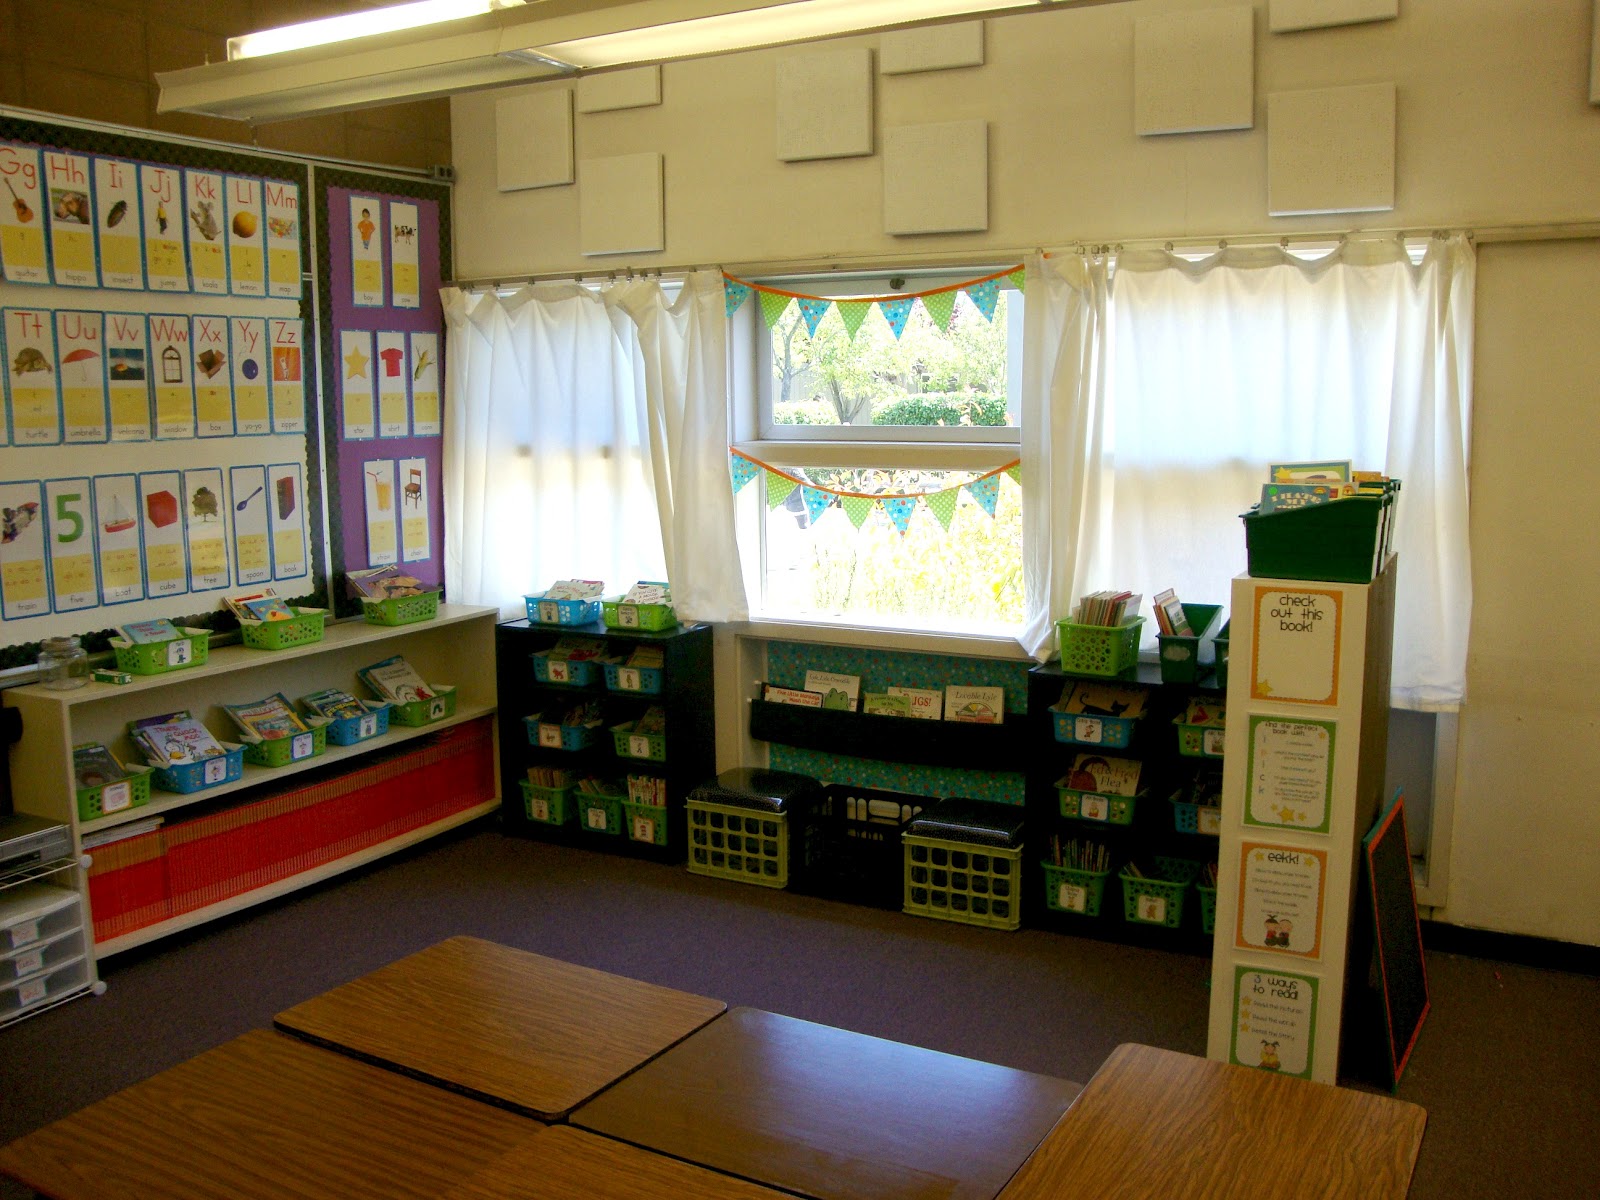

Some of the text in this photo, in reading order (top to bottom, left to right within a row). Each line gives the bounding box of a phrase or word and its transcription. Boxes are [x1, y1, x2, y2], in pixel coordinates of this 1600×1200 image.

[0, 149, 36, 189] Gg
[51, 155, 84, 184] Hh
[110, 164, 122, 188] Ii
[150, 170, 171, 203] Jj
[194, 176, 215, 200] Kk
[236, 181, 252, 204] Ll
[266, 186, 297, 209] Mm
[15, 270, 38, 279] guitar
[65, 272, 87, 282] hippo
[112, 276, 134, 284] insect
[159, 279, 177, 288] jump
[202, 281, 218, 289] koala
[239, 283, 257, 291] lemon
[363, 294, 373, 303] boy
[14, 312, 43, 338] Tt
[62, 315, 97, 340] Uu
[113, 317, 139, 341] Vv
[150, 318, 188, 343] Ww
[199, 320, 222, 342] Xx
[238, 320, 258, 353] Yy
[275, 321, 296, 344] Zz
[163, 425, 188, 434] window
[209, 423, 222, 431] box
[244, 422, 262, 431] yo-yo
[281, 420, 298, 430] zipper
[25, 430, 49, 439] turtle
[70, 429, 101, 438] umbrella
[117, 427, 144, 436] volcano
[56, 493, 84, 543] 5
[284, 564, 297, 573] book
[203, 576, 218, 584] tree
[246, 570, 264, 580] spoon
[159, 581, 177, 591] cube
[70, 595, 84, 604] five
[1280, 594, 1316, 607] check
[1270, 608, 1324, 620] out this
[1280, 620, 1313, 632] book!
[955, 691, 998, 702] Lovable Lyle
[1268, 852, 1299, 865] eekk!
[1254, 974, 1298, 990] 3 ways
[1252, 985, 1298, 1000] to read
